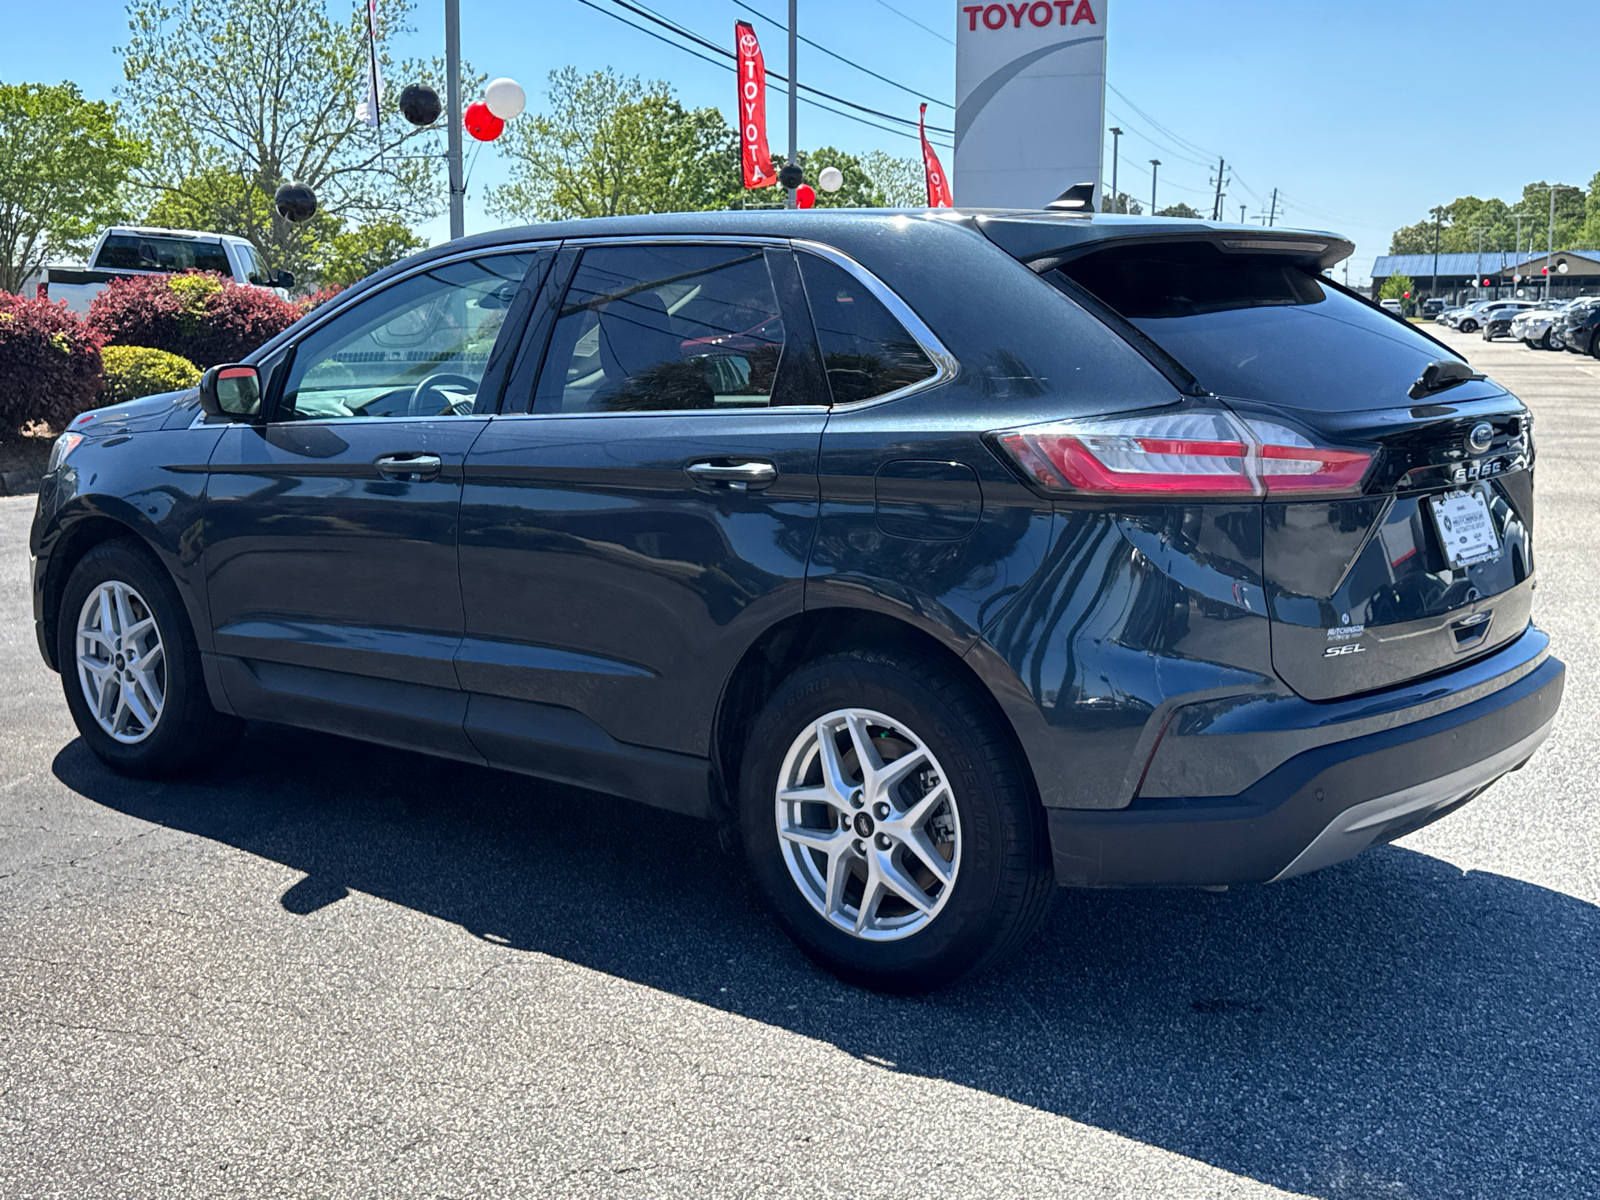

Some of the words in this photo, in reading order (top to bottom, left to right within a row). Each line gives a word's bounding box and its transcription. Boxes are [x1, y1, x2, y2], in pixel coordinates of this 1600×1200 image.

[963, 0, 1096, 31] TOYOTA
[744, 61, 767, 182] TOYOTA
[1454, 462, 1501, 482] EDGE
[1327, 625, 1364, 636] HUTCHINSON
[1323, 643, 1366, 658] SEL
